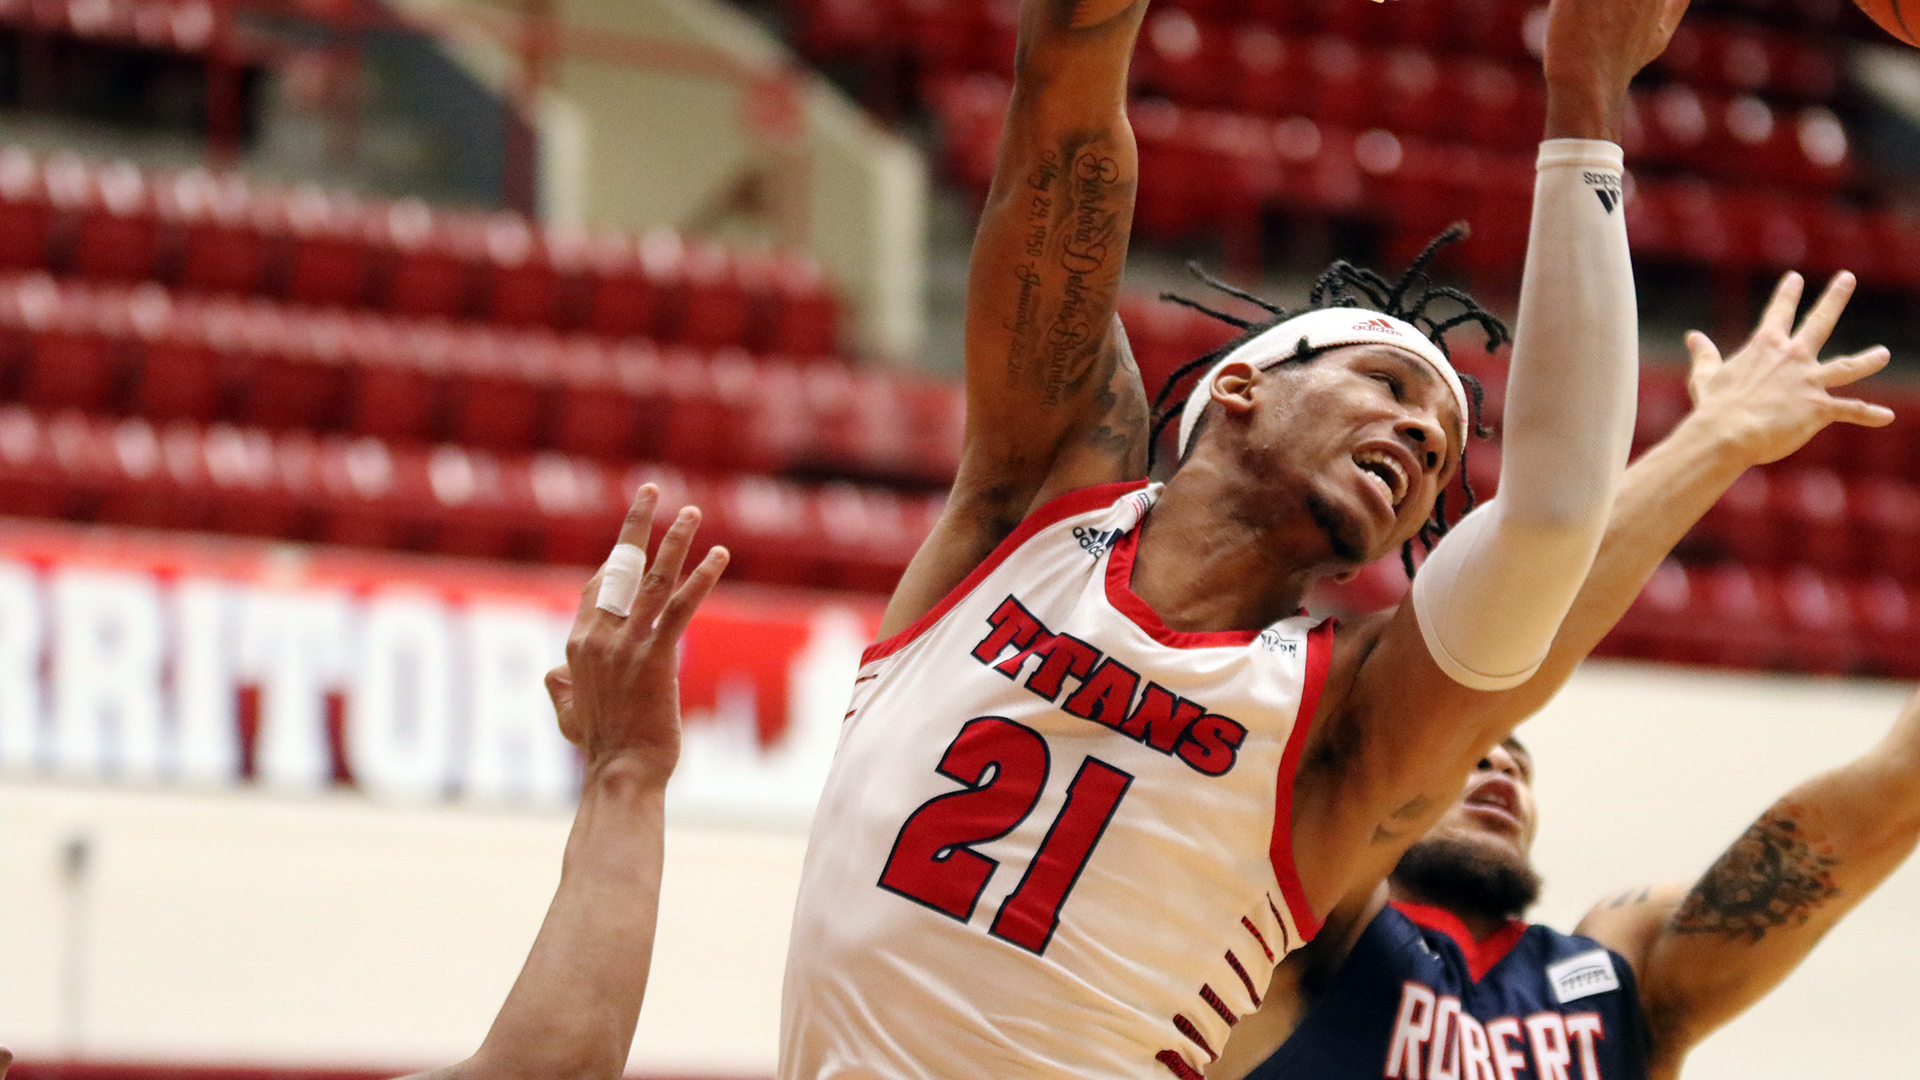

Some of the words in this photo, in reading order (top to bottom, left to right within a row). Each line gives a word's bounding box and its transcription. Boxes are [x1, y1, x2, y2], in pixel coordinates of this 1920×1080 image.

[1352, 324, 1403, 337] adidas
[1072, 526, 1105, 560] adida
[971, 594, 1249, 777] TITANS
[876, 716, 1136, 957] 21
[1383, 980, 1605, 1080] ROBERT
